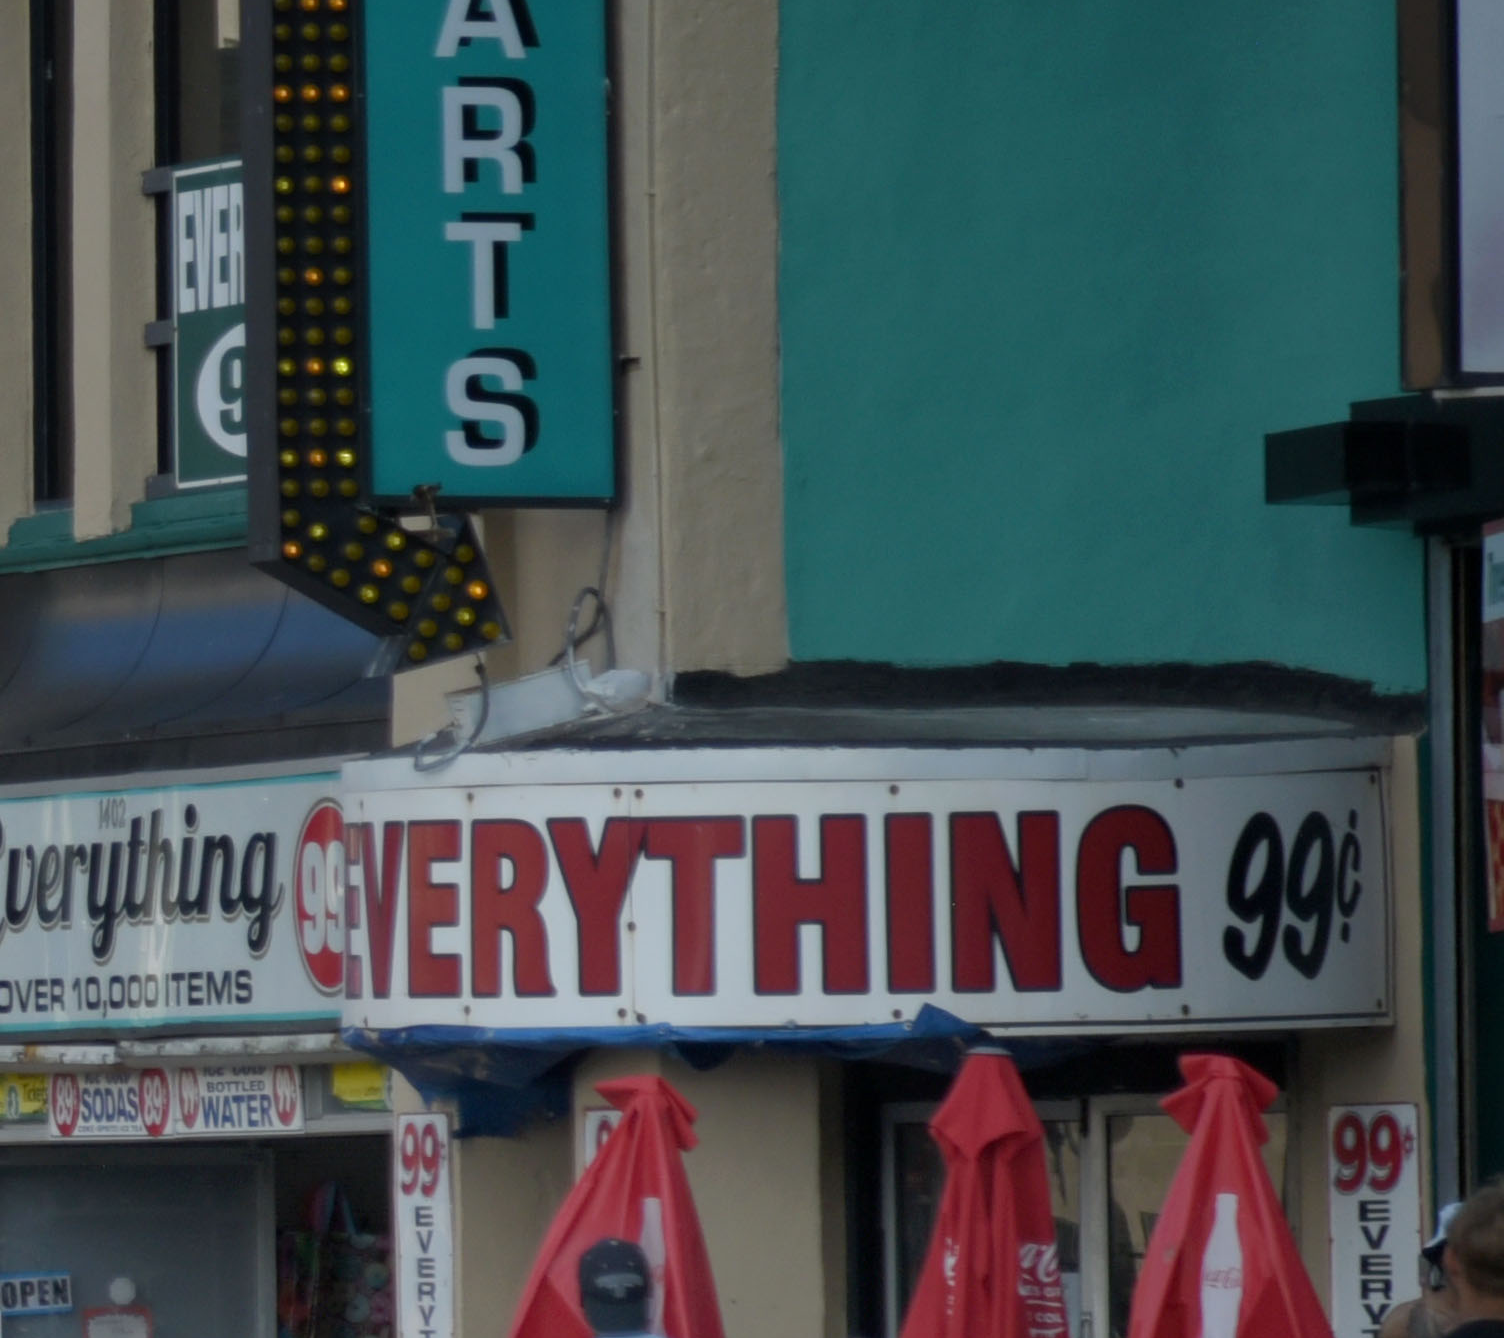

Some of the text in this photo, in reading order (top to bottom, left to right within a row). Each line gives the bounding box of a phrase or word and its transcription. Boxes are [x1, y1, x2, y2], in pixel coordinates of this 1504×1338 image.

[98, 798, 127, 830] 1402
[345, 803, 1363, 1000] EVERYTHING 99¢
[71, 973, 160, 1019] 10,000
[164, 969, 254, 1006] ITEMS
[81, 1085, 138, 1123] SODAS
[206, 1079, 266, 1093] BOTTLED
[201, 1093, 274, 1129] WATER
[0, 1278, 70, 1309] OPEN
